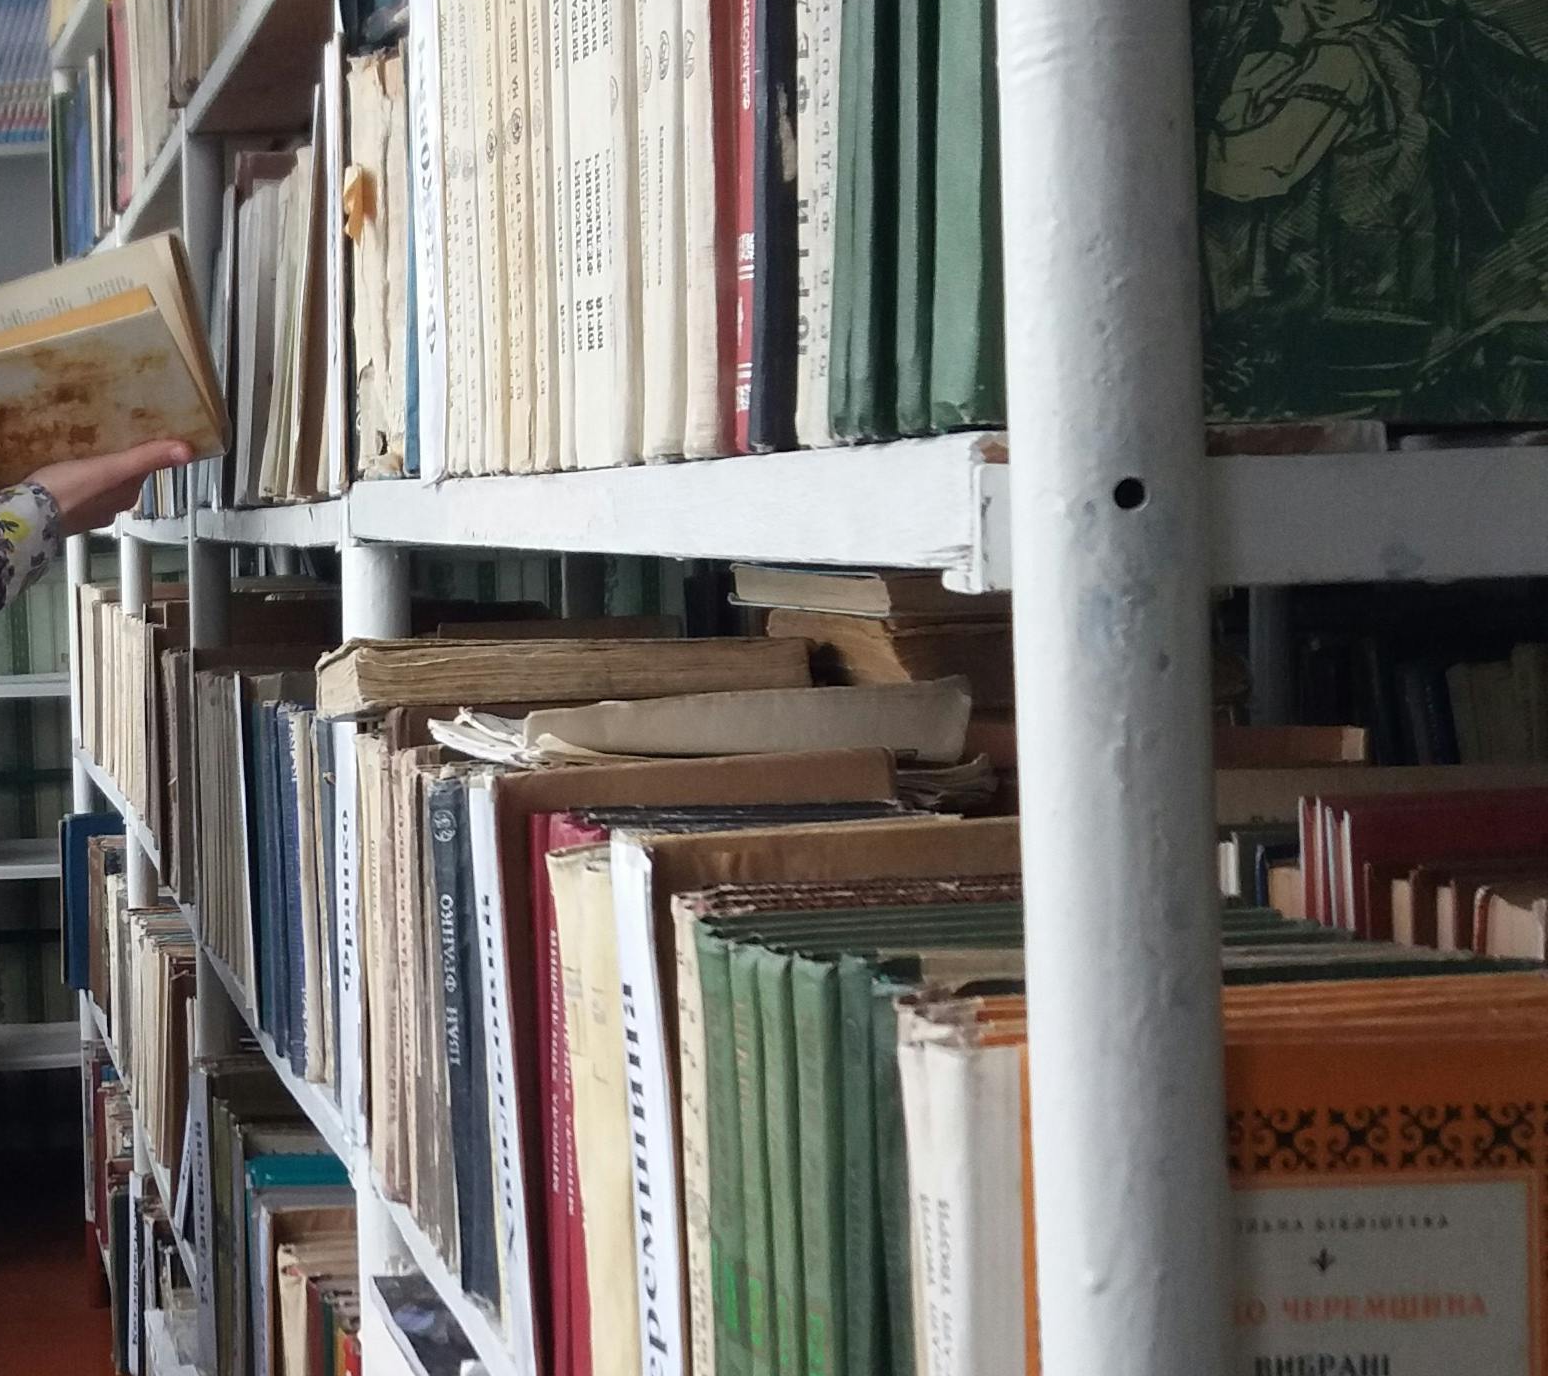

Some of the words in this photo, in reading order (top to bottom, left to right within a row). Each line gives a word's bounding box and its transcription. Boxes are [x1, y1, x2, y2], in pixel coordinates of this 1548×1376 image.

[510, 15, 518, 64] ДЕНЬ
[513, 75, 519, 100] НА
[487, 100, 493, 121] НА
[417, 37, 436, 355] Федькович
[574, 159, 582, 278] ФЕДЬКОВИЧ
[585, 156, 593, 276] ФЕДЬКОВИЧ
[594, 152, 602, 274] ФЕДЬКОВИЧ
[466, 199, 475, 360] ФЕДЬКОВИЧ
[596, 296, 604, 351] ЮРІЙ
[797, 197, 809, 356] ЮРІЙ
[340, 809, 353, 992] Франко
[440, 893, 457, 993] ФРАНКО
[446, 1006, 461, 1067] ІВАН
[1282, 1292, 1488, 1324] ЧЕРЕМШИНА
